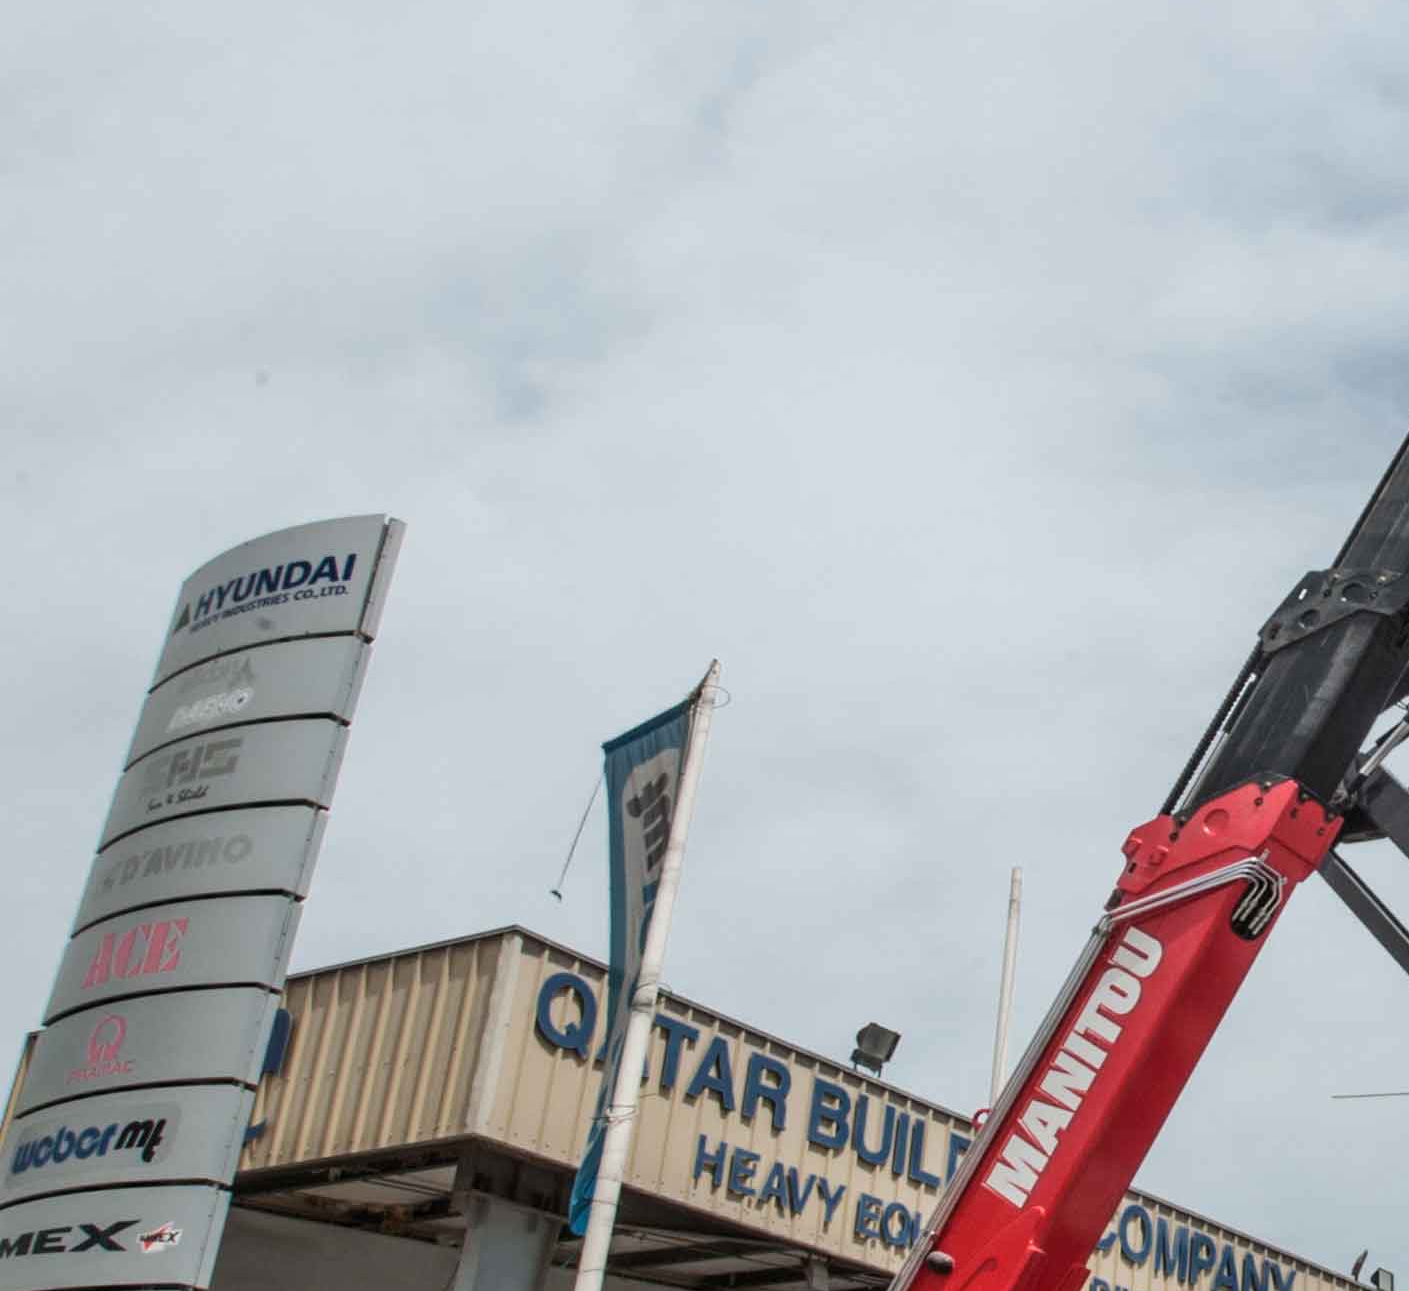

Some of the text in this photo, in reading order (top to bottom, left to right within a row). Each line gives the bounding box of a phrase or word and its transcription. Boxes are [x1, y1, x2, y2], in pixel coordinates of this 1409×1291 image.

[193, 553, 357, 622] HYUNDAI
[81, 917, 190, 990] ACE
[536, 972, 791, 1132] QTAR
[983, 925, 1163, 1209] MANITOU
[693, 1133, 847, 1224] HEAVY
[0, 1219, 141, 1258] MEX
